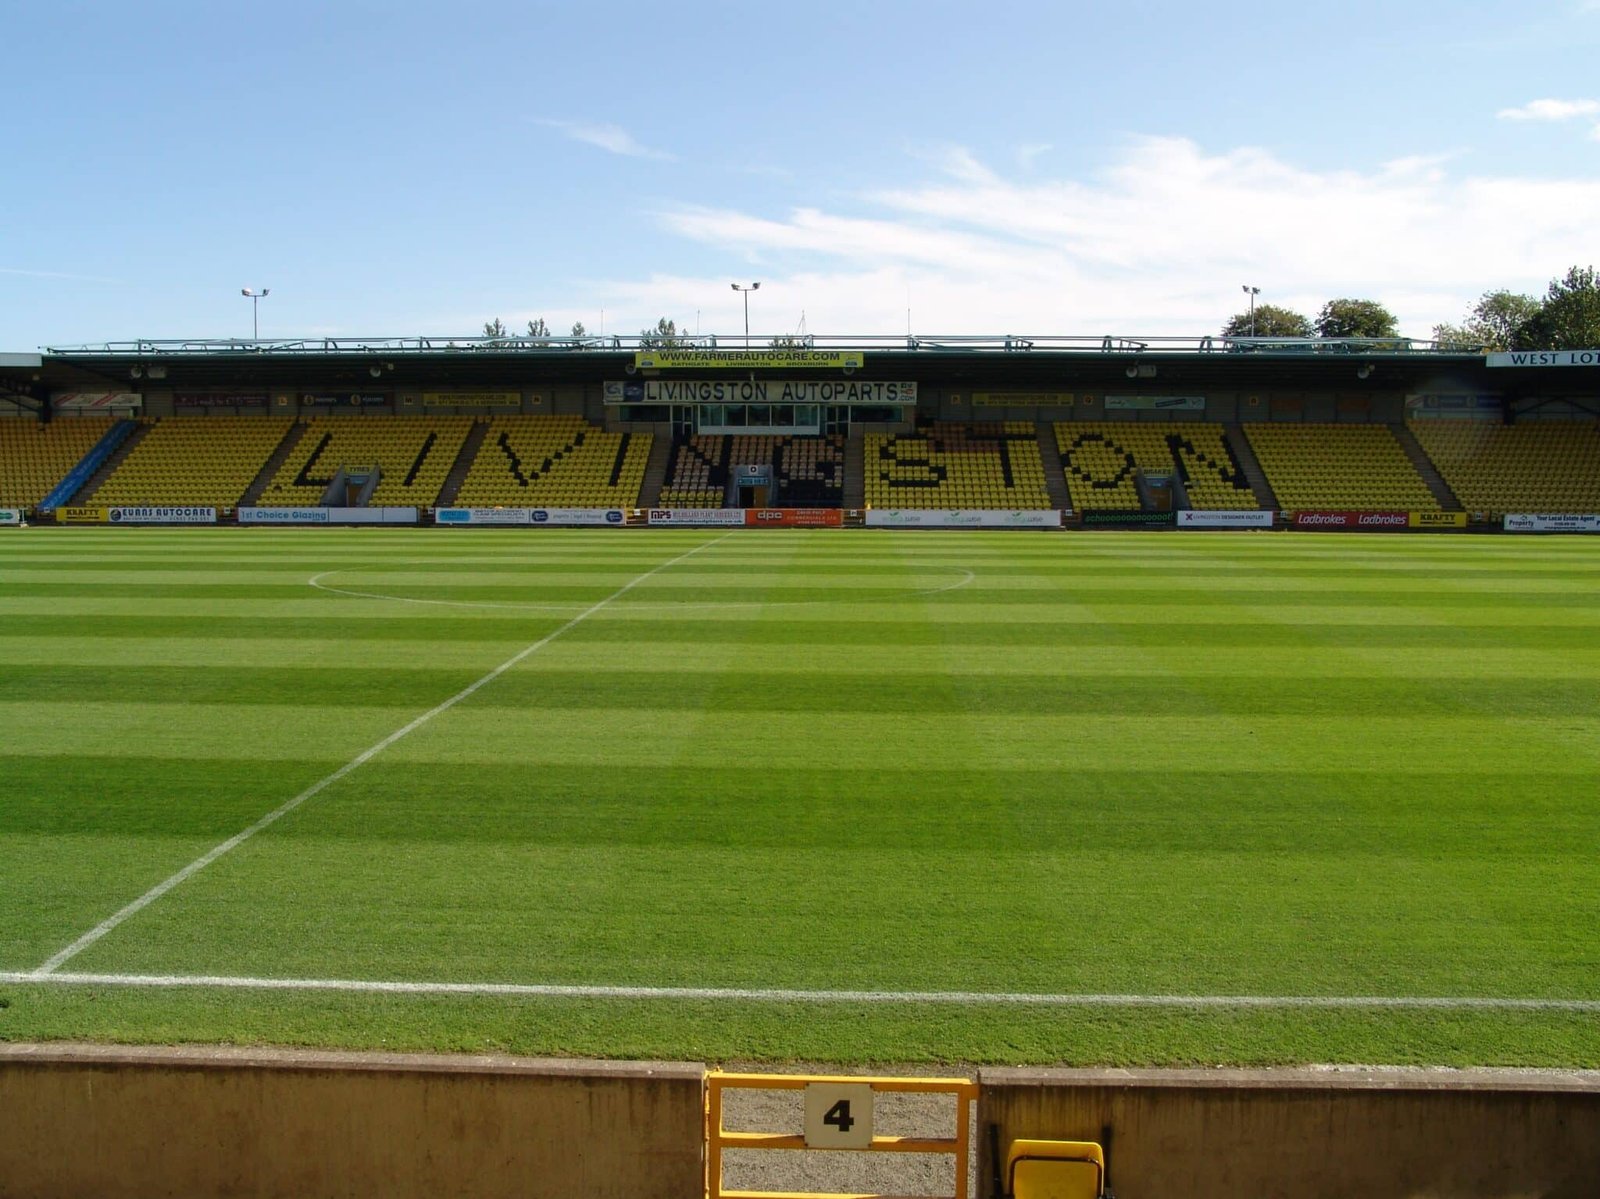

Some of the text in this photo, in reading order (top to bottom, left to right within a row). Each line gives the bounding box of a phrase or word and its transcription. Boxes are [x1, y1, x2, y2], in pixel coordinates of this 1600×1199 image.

[659, 353, 839, 361] WWW.FARMERAUTOCARE.COM
[1511, 353, 1559, 365] WEST
[646, 383, 768, 401] LIVINGSTON
[781, 383, 898, 401] AUTOPARTS
[256, 511, 289, 519] Choice
[292, 511, 326, 520] Glazing
[651, 510, 671, 519] MPS
[1298, 514, 1347, 524] Ladbrokes
[1359, 514, 1407, 524] Ladbrokes
[1509, 519, 1534, 527] Property
[823, 1099, 855, 1132] 4
